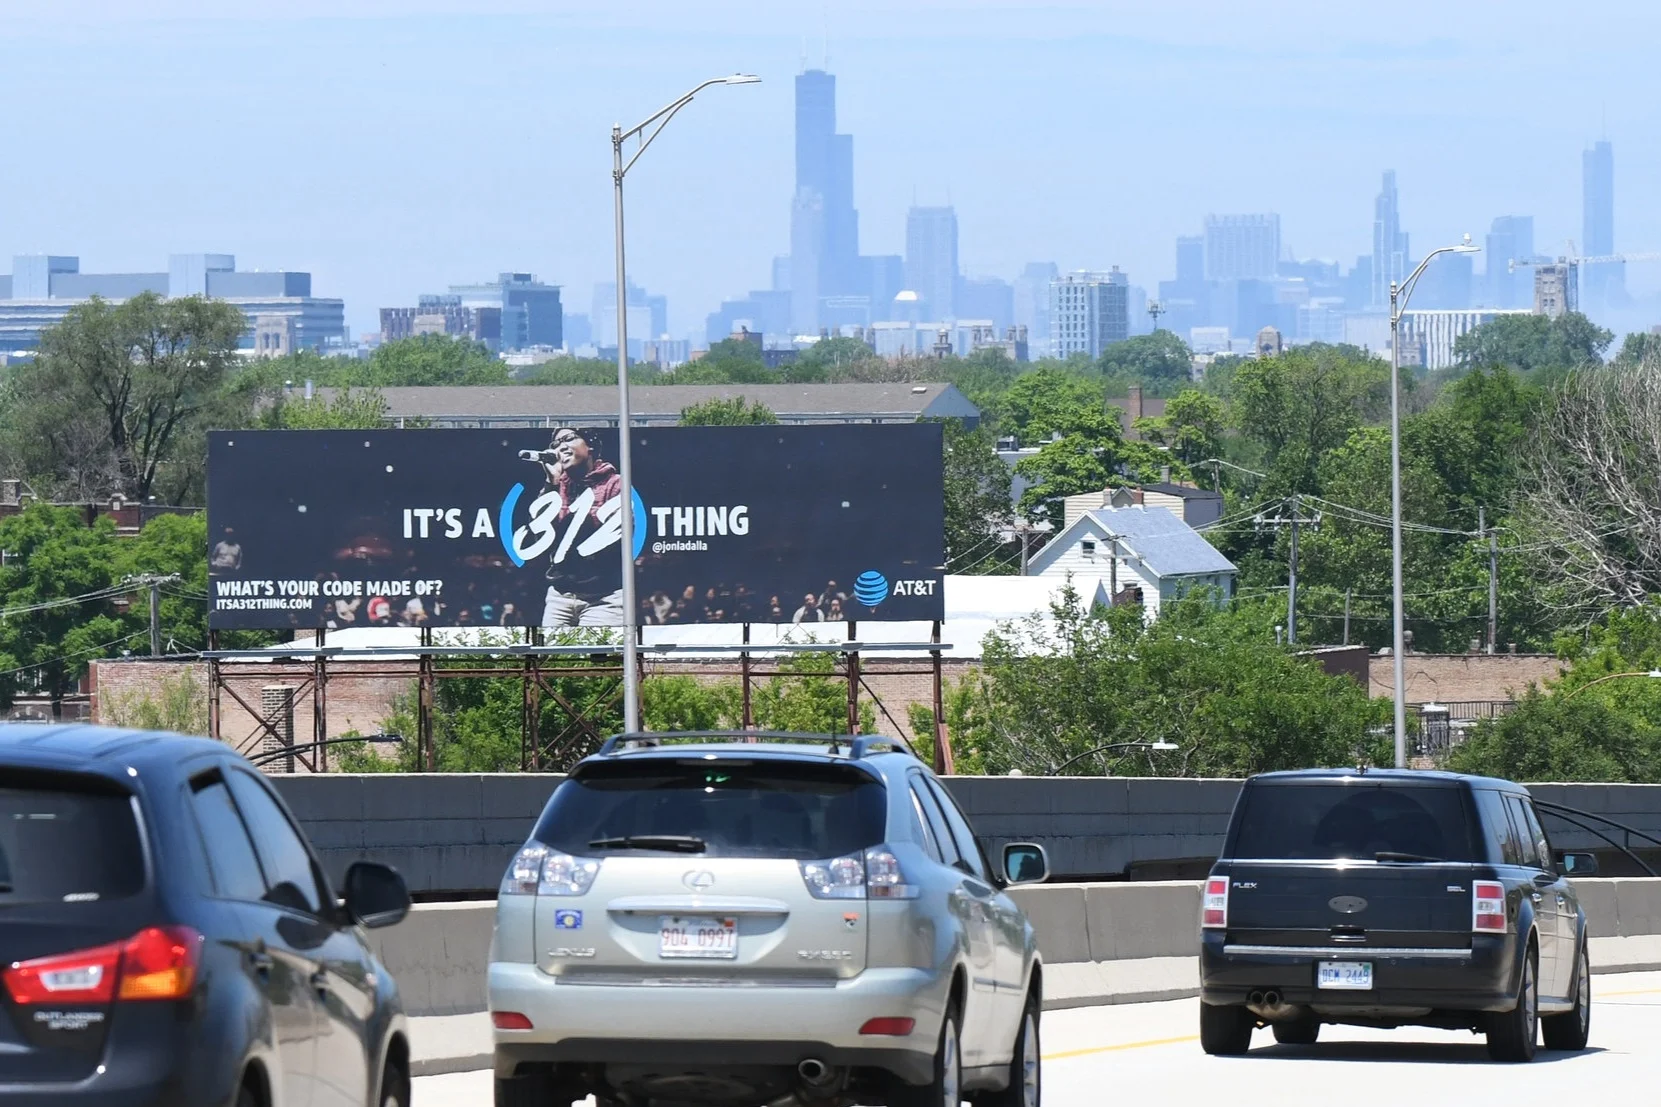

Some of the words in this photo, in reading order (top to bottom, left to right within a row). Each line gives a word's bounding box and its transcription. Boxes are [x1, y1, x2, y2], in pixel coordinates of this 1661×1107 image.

[402, 508, 463, 539] IT'S
[471, 508, 495, 538] A
[651, 505, 749, 537] THING
[216, 580, 274, 597] WHAT'S
[277, 580, 319, 597] YOUR
[322, 580, 363, 596] CODE
[366, 580, 411, 596] MADE
[414, 579, 443, 596] OF?
[893, 580, 937, 596] AT&T
[216, 598, 312, 610] ITSA312THING.COM
[1232, 881, 1258, 889] FLEX
[547, 947, 596, 957] LEXUS
